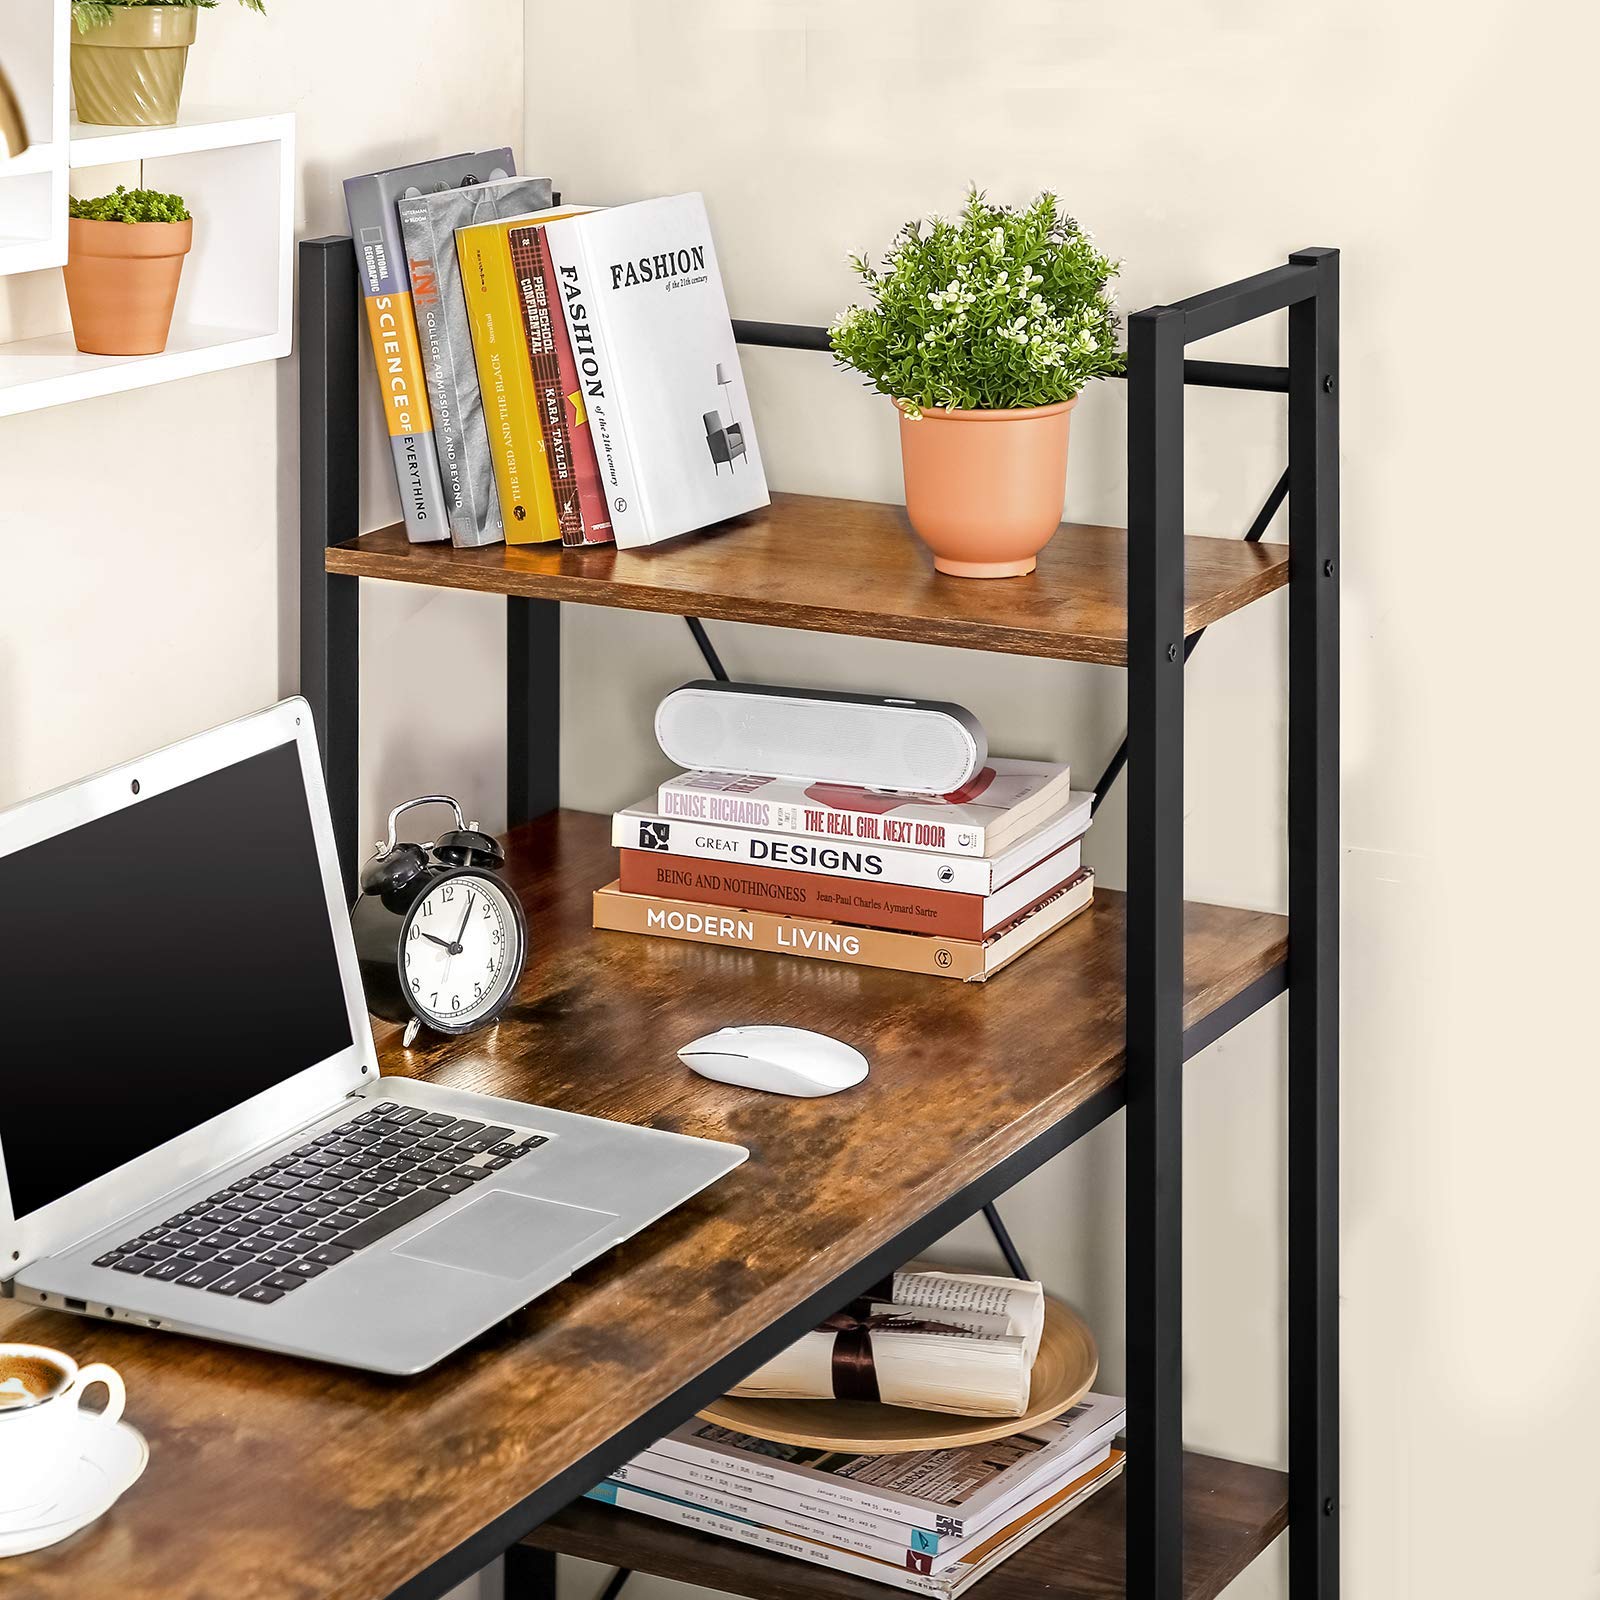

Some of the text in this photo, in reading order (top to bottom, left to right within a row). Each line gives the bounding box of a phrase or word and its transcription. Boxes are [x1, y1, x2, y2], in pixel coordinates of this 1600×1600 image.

[363, 245, 380, 293] GEOGRAPHIC
[374, 244, 389, 280] NATIONAL
[610, 245, 706, 290] FASHION
[672, 279, 680, 289] the
[691, 275, 708, 286] century
[520, 278, 543, 354] CONFIDENTIAL
[533, 275, 554, 354] PREP SCHOOL
[560, 265, 606, 398] FASHION
[376, 297, 427, 520] SCIENCE OF EVERYTHING
[426, 312, 463, 508] COLLEGE ADMISSIONS AND BEYOND
[594, 405, 606, 418] of
[491, 354, 521, 502] THE RED AND THE BLACK
[545, 387, 568, 480] KARA TAYLOR
[598, 418, 608, 432] the
[606, 453, 619, 487] century
[665, 791, 770, 826] DENISE RICHARDS
[804, 809, 825, 833] THE
[827, 812, 854, 837] REAL
[856, 815, 881, 840] GIRL
[883, 819, 913, 844] NEXT
[915, 824, 946, 848] DOOR
[695, 836, 883, 875] GREAT DESIGNS
[441, 886, 454, 903] 12
[657, 868, 807, 903] BEING AND NOTHINGNESS
[422, 901, 433, 916] 11
[483, 904, 491, 920] 2
[816, 890, 938, 918] Jean-Paul Charles Aymard Sartre
[408, 924, 420, 941] 10
[492, 930, 500, 945] 3
[647, 908, 860, 955] MODERN LIVING
[486, 957, 495, 972] 4
[411, 977, 420, 993] 8
[473, 982, 482, 998] 5
[430, 993, 439, 1008] 7
[451, 995, 460, 1010] 6
[799, 1502, 816, 1512] August
[817, 1488, 838, 1499] January
[784, 1519, 811, 1531] November
